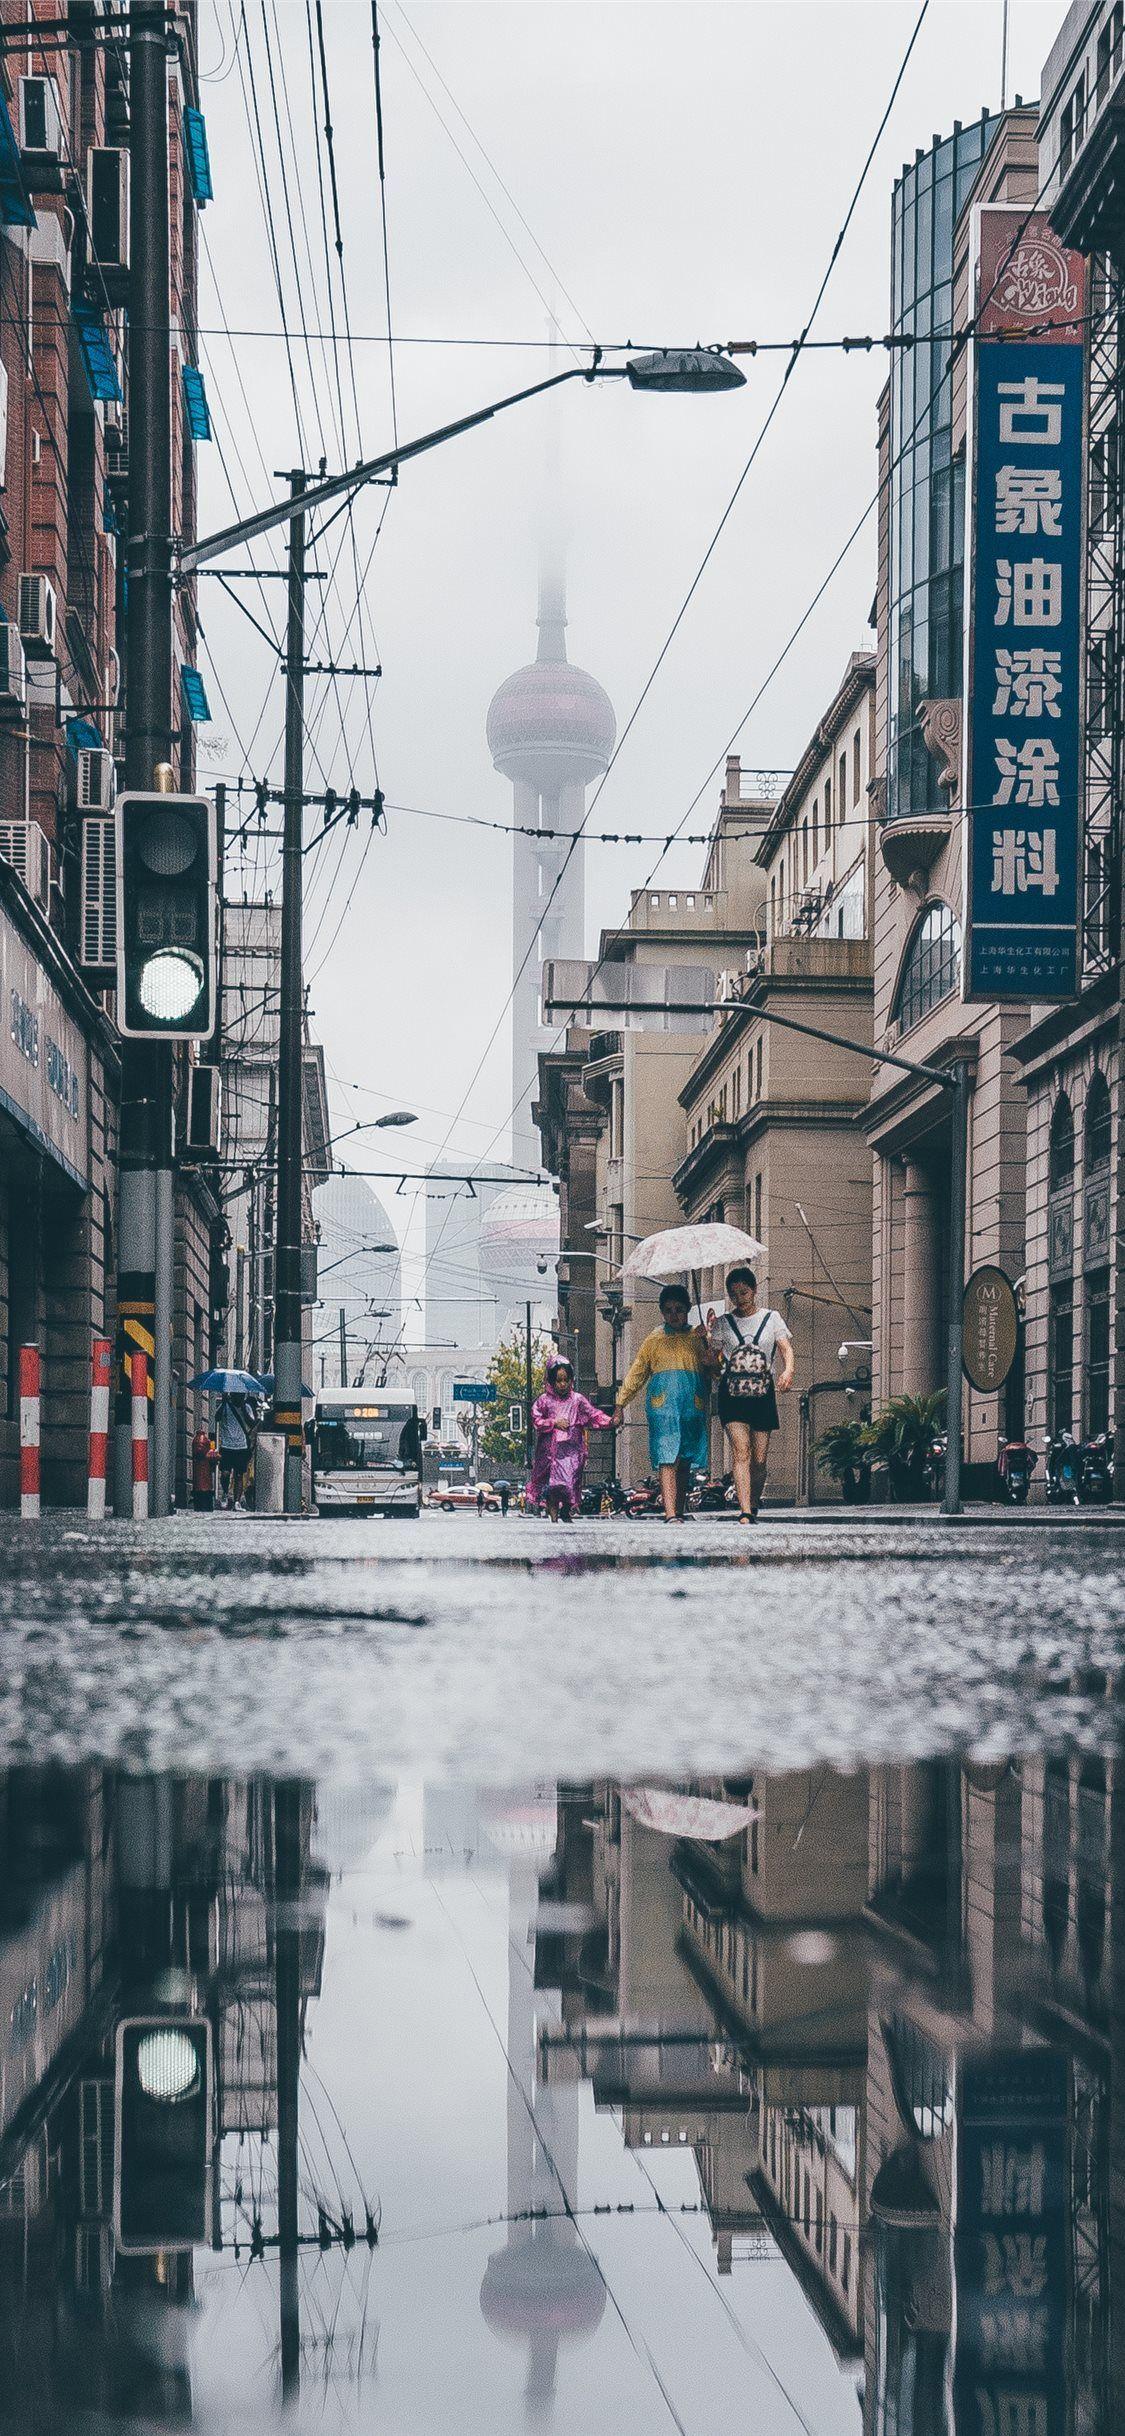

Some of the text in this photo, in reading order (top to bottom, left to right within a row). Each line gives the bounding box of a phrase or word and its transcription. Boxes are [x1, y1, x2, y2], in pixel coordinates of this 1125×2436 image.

[991, 376, 1066, 896] 古象油漆涂料
[988, 1305, 998, 1378] Maternal Care
